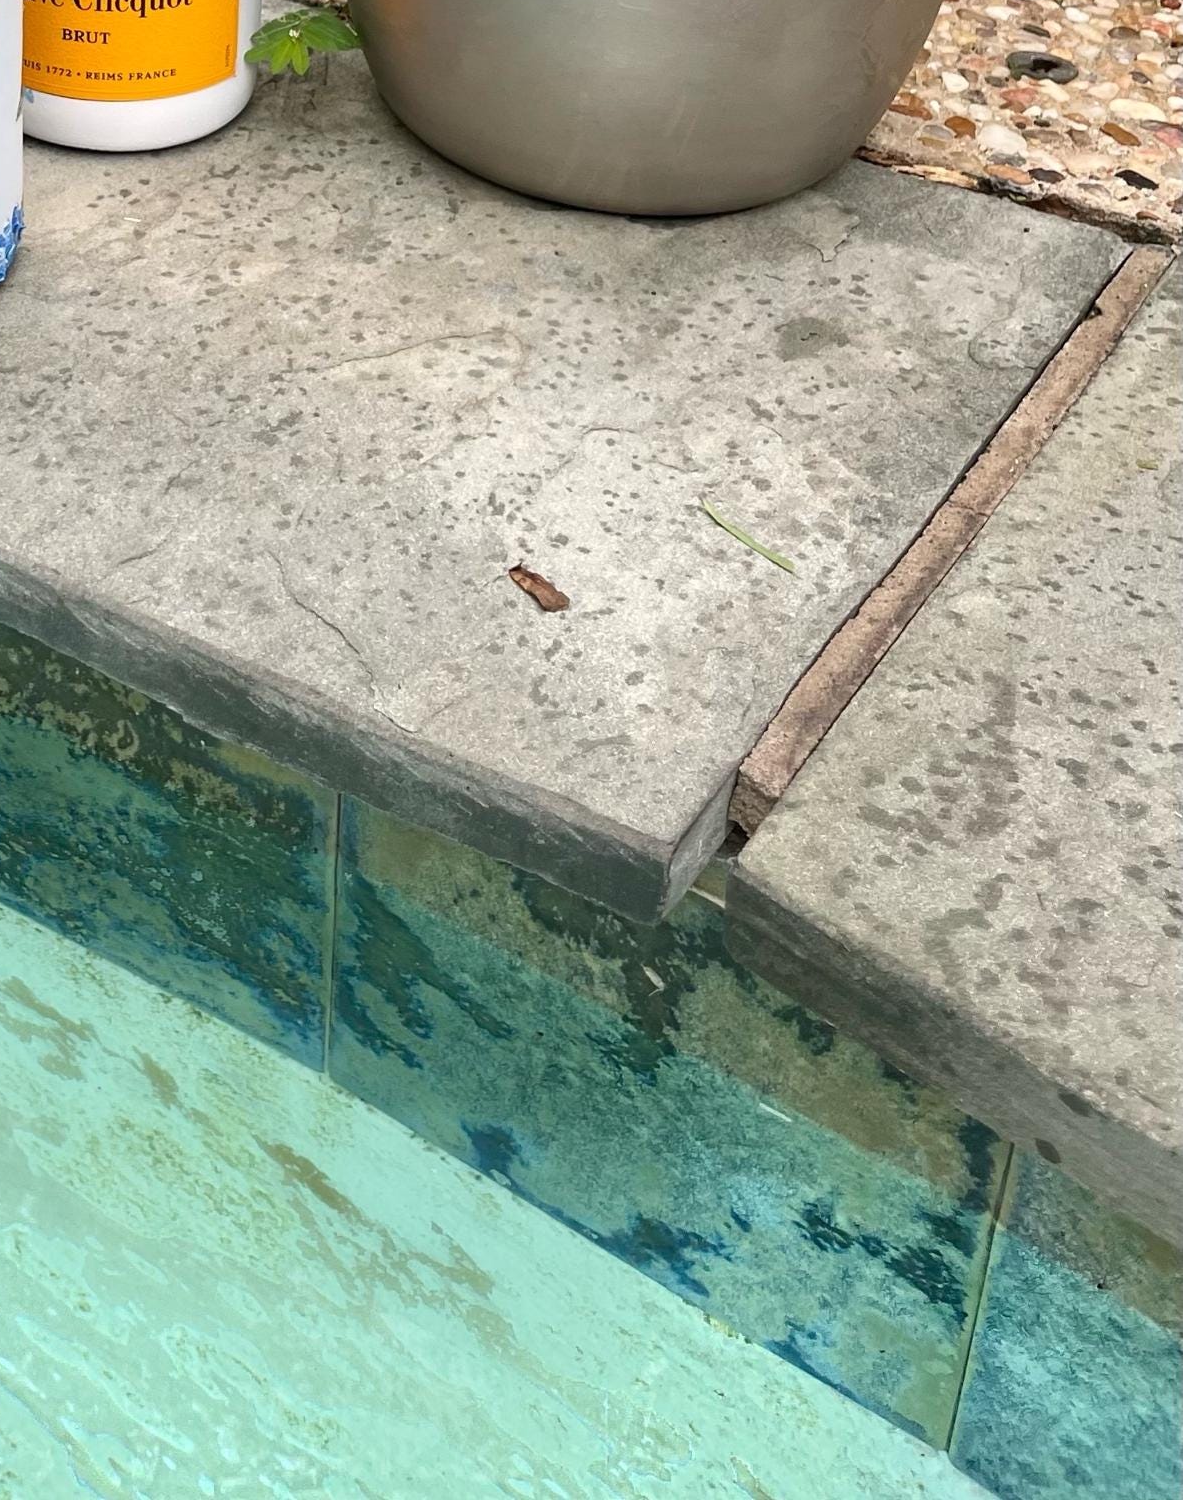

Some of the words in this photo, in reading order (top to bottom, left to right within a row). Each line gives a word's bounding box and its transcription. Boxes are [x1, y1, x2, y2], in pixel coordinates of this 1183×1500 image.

[61, 28, 111, 45] BRUT
[24, 59, 41, 71] UIS
[46, 65, 73, 78] 1772
[85, 71, 123, 81] REIMS
[129, 68, 177, 81] FRANCE
